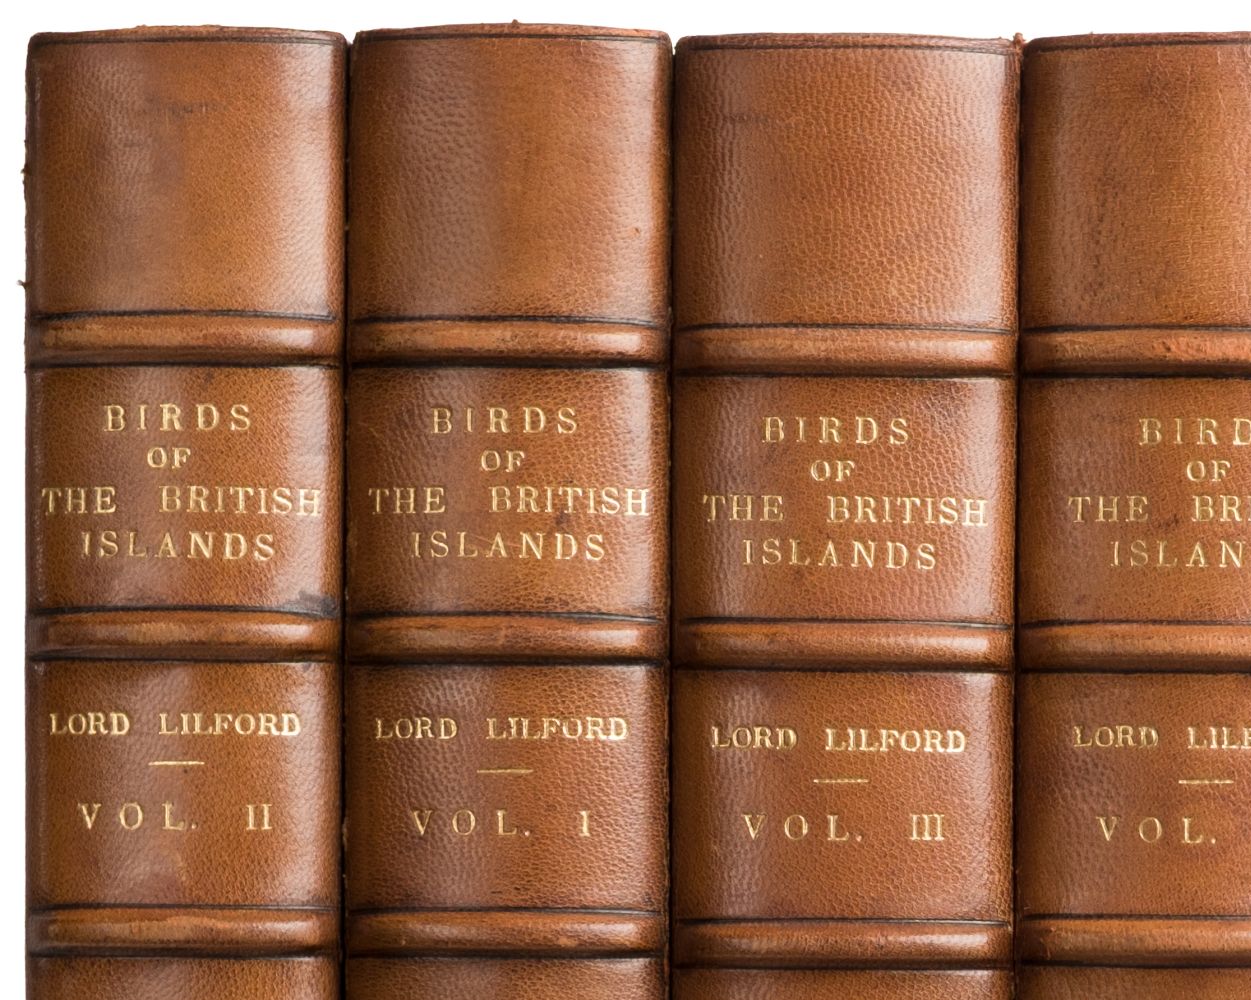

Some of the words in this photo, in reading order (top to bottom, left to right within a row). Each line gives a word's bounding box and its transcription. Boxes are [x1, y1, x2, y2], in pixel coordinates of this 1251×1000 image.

[103, 403, 252, 432] BIRDS
[432, 407, 578, 435] BIRDS
[762, 416, 911, 445] BIRDS
[147, 446, 192, 469] OF
[480, 449, 525, 473] OF
[810, 460, 857, 482] OF
[1186, 459, 1232, 482] OF
[42, 486, 117, 516] THE
[159, 486, 322, 517] BRITISH
[368, 486, 446, 514] THE
[490, 486, 650, 517] BRITISH
[702, 494, 785, 523] THE
[826, 495, 989, 527] BRITISH
[1068, 495, 1150, 523] THE
[80, 531, 275, 561] ISLANDS
[411, 532, 605, 561] ISLANDS
[743, 539, 938, 570] ISLANDS
[49, 712, 131, 737] LORD
[158, 712, 302, 737] LILFORD
[375, 717, 458, 740] LORD
[486, 717, 628, 741] LILFORD
[1073, 725, 1159, 748] LORD
[711, 726, 797, 750] LORD
[825, 728, 967, 754] LILFORD
[78, 802, 197, 831] VOL.
[246, 803, 273, 831] II
[410, 810, 531, 836] VOL.
[579, 810, 592, 837] I
[743, 814, 863, 842] VOL.
[910, 814, 946, 841] III
[1097, 816, 1217, 844] VOL.
